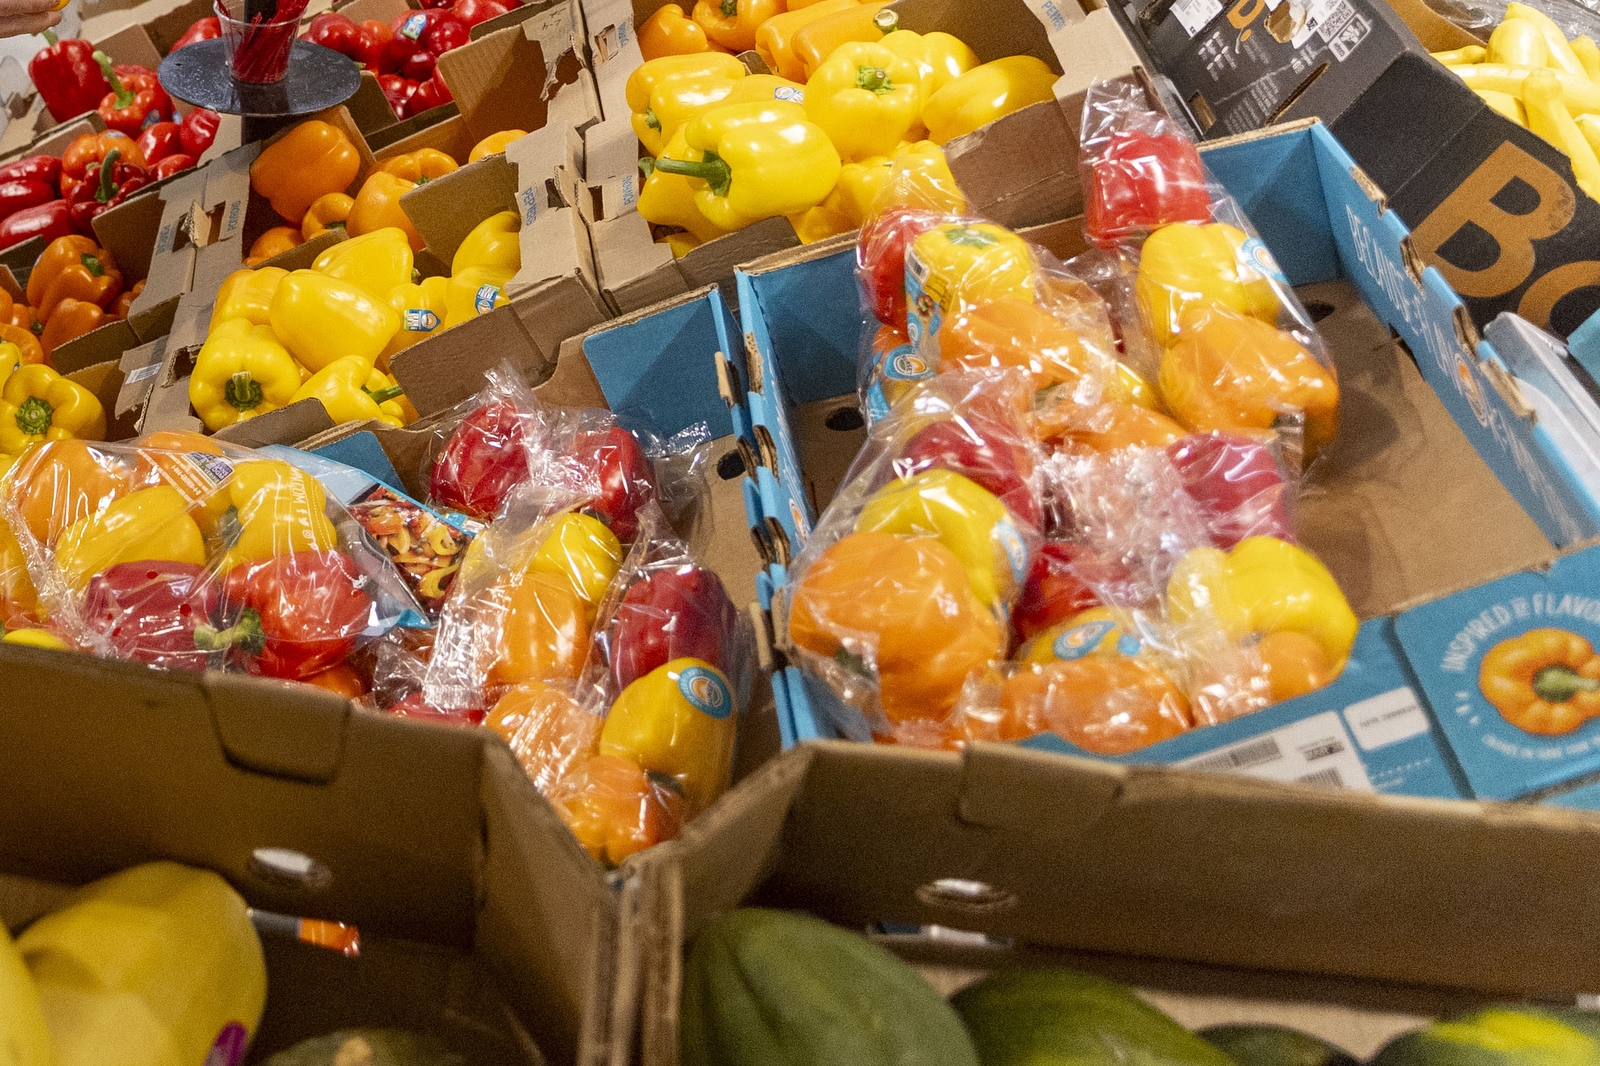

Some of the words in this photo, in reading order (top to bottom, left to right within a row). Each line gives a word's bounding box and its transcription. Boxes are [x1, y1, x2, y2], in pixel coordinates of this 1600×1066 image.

[210, 465, 225, 481] OGM
[1439, 605, 1512, 672] INSPIRED
[1532, 592, 1600, 624] FLAVO
